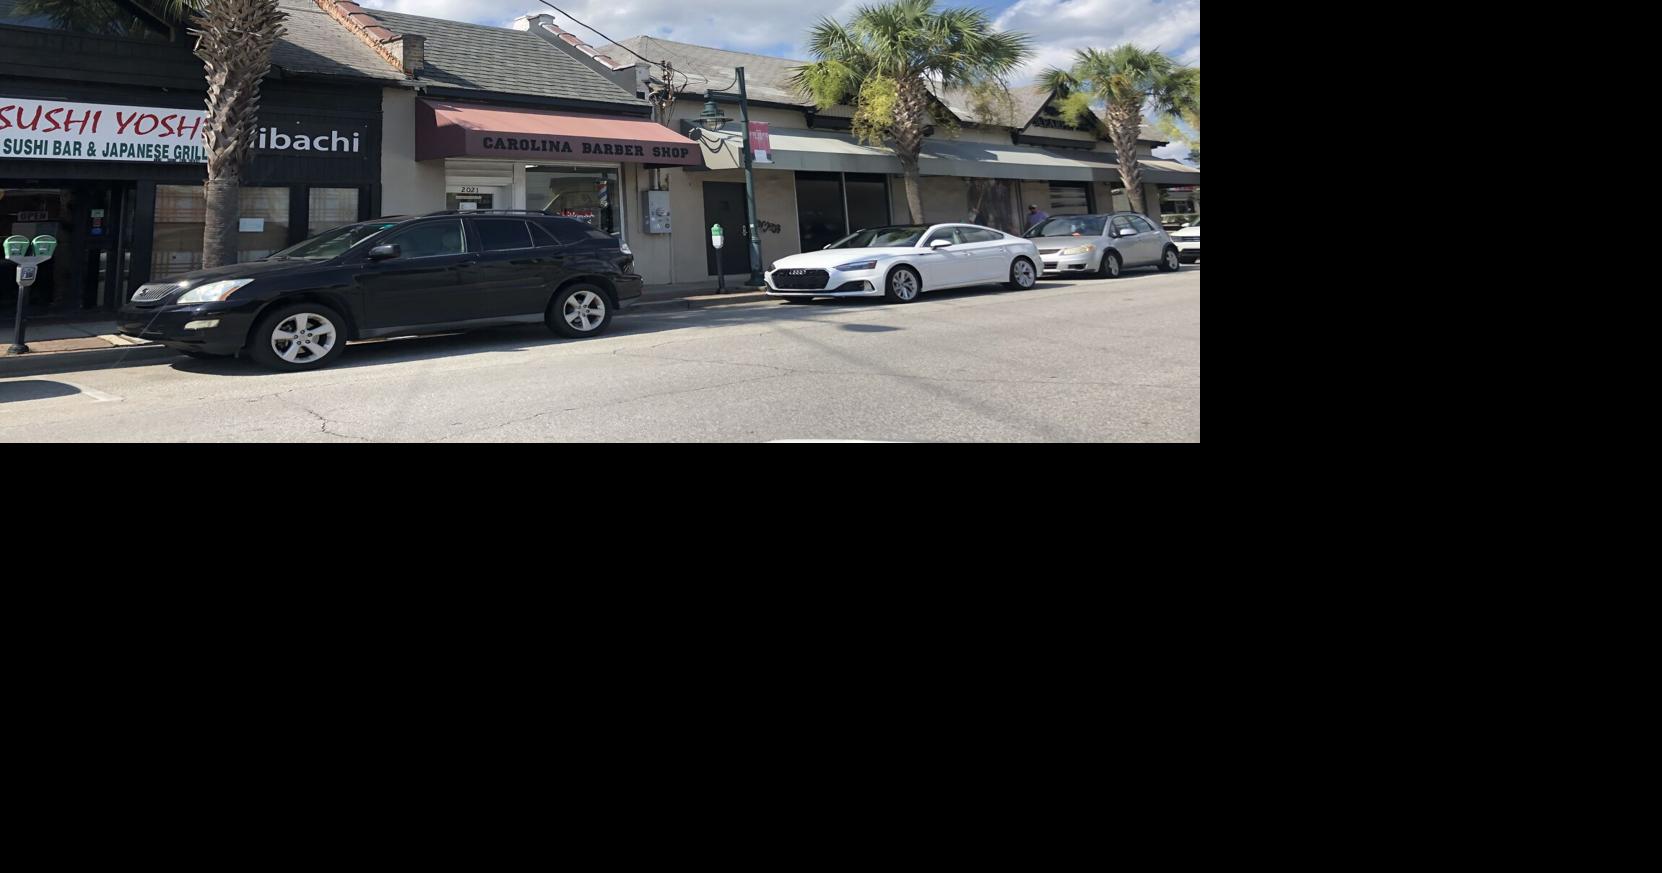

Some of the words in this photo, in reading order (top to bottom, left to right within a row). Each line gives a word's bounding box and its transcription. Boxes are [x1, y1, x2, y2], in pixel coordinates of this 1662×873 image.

[0, 105, 102, 135] SUSHI
[116, 112, 208, 140] YOSH
[3, 138, 48, 155] SUSHI
[53, 140, 82, 156] BAR
[87, 141, 96, 157] &
[102, 142, 170, 159] JAPANESE
[173, 144, 208, 161] GRILL
[248, 127, 359, 152] ibachi
[482, 137, 573, 153] CAROLINA
[582, 142, 645, 157] BARBER
[652, 146, 689, 159] SHOP
[20, 212, 47, 220] OPEN
